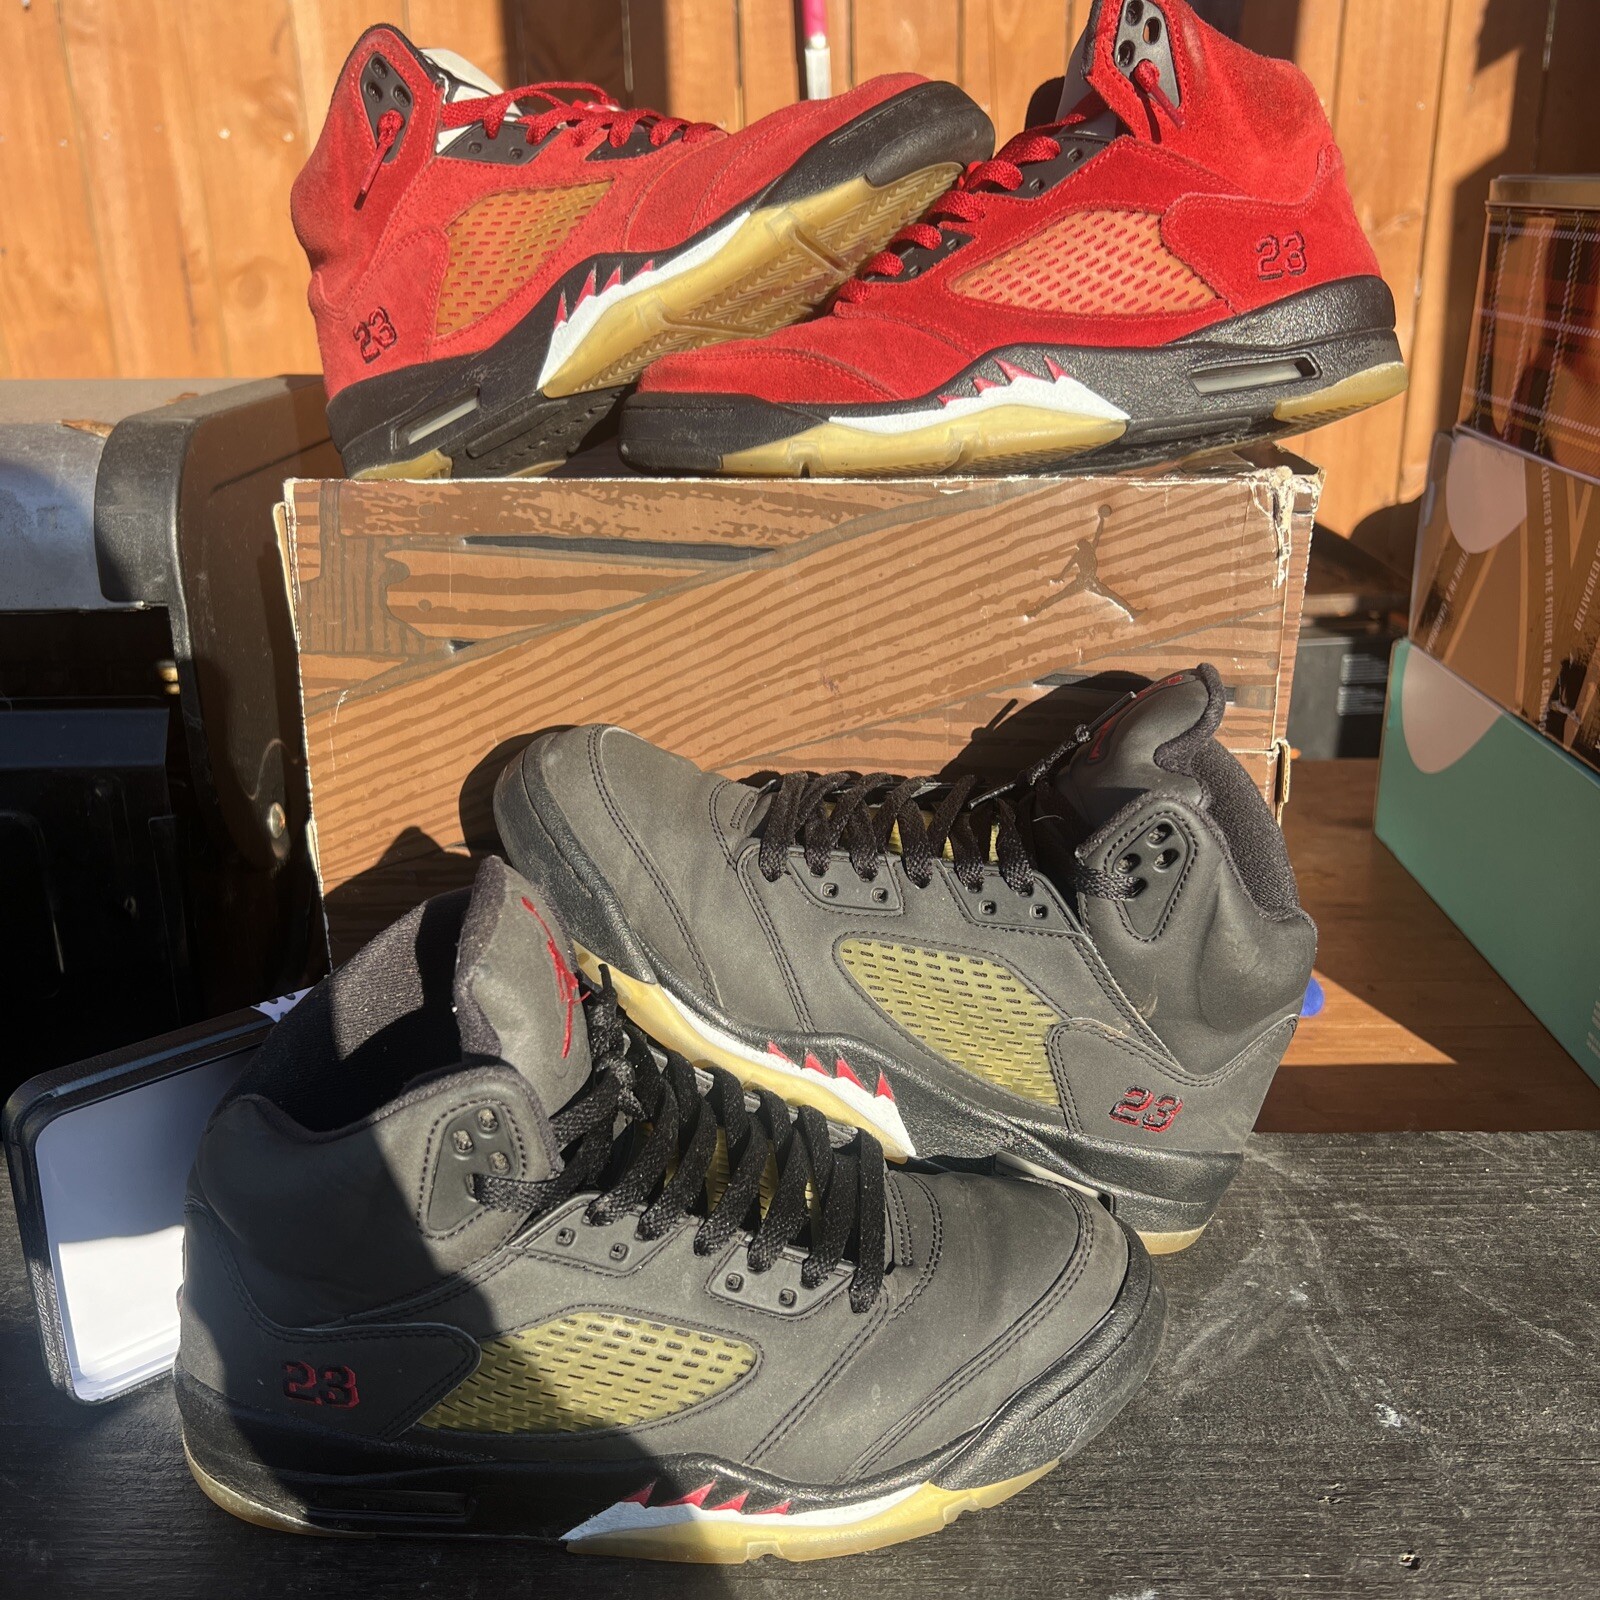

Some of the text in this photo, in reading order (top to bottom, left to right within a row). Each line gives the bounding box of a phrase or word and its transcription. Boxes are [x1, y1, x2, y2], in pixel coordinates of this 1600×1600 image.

[1256, 231, 1307, 280] 23
[353, 306, 397, 363] 23
[1544, 528, 1553, 566] FROM
[1544, 568, 1554, 594] THE
[1573, 560, 1600, 631] DELIVERED
[1544, 596, 1554, 646] FUTURE
[1543, 648, 1553, 663] IN
[1109, 1085, 1183, 1133] 23
[282, 1361, 360, 1410] 23
